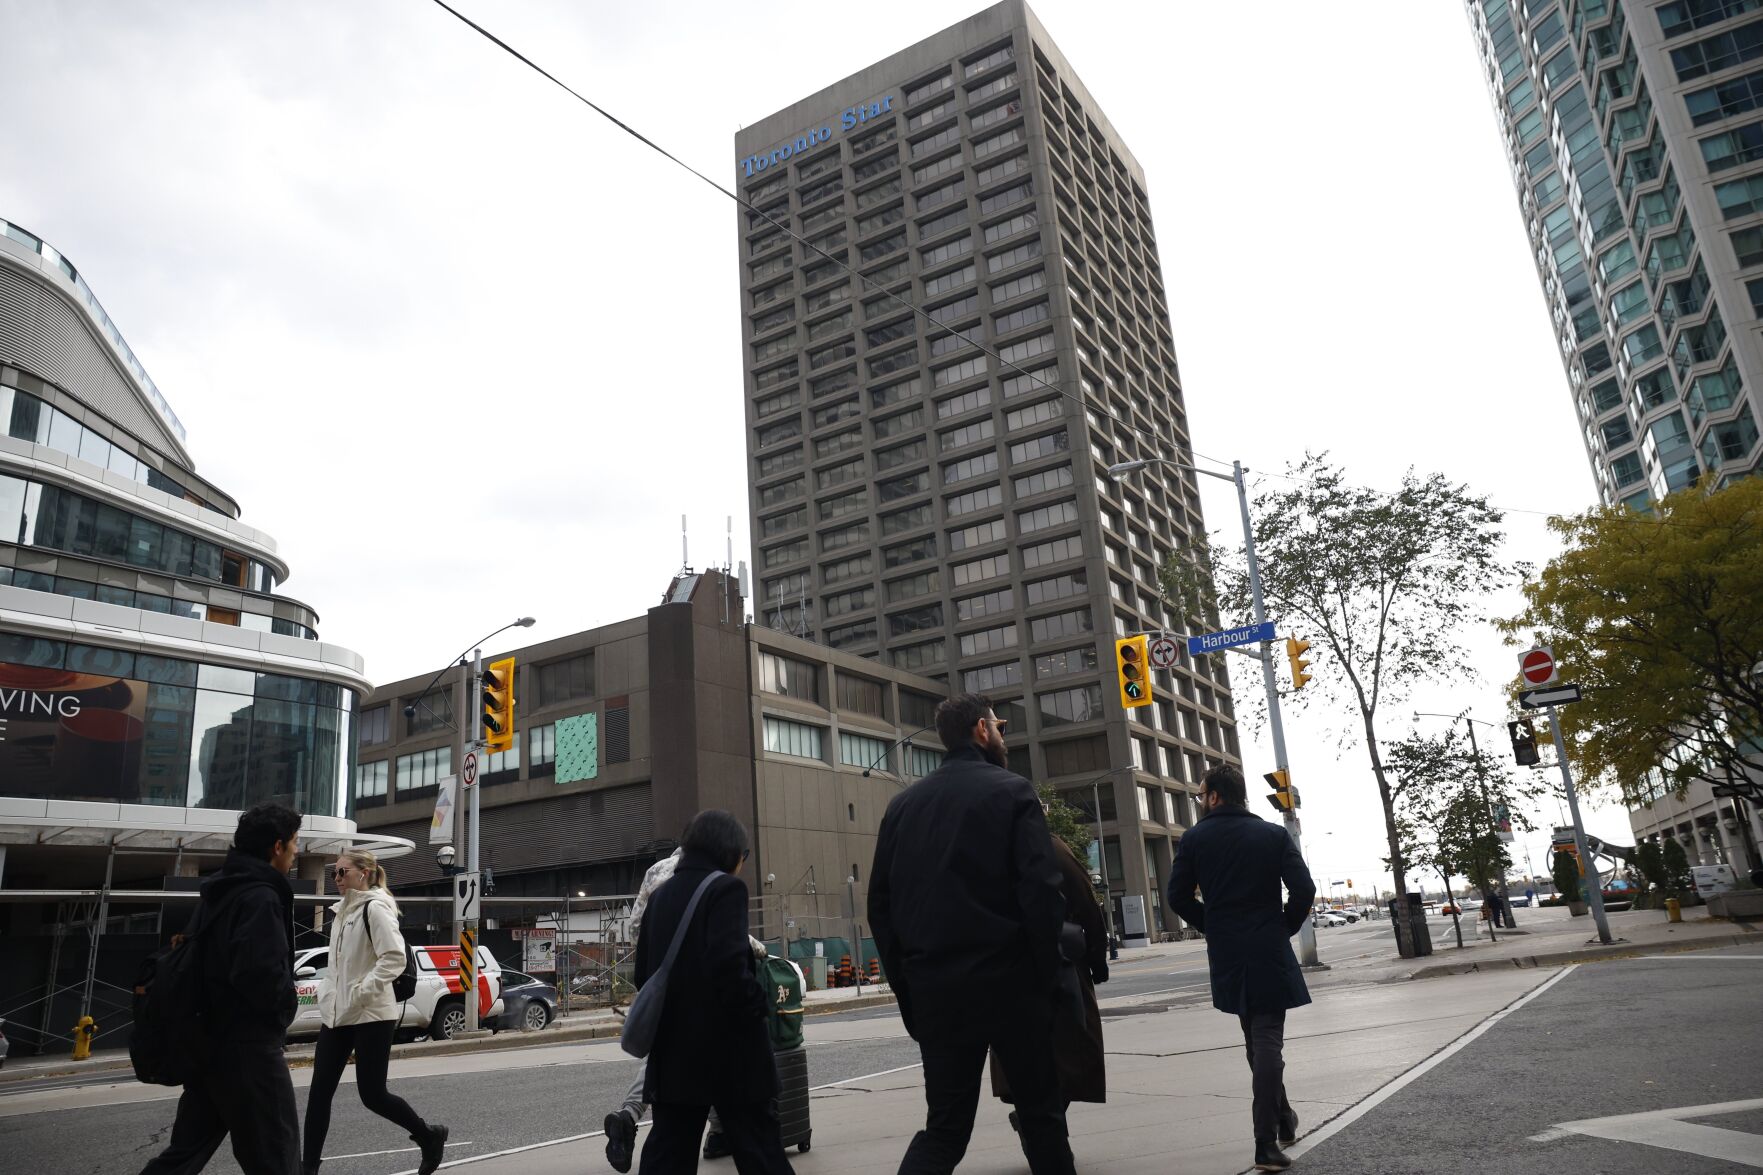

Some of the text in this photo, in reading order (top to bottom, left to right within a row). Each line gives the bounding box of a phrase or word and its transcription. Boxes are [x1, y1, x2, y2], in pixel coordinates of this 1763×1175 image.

[740, 95, 894, 177] Toronto Star
[1202, 626, 1259, 648] Harbour St
